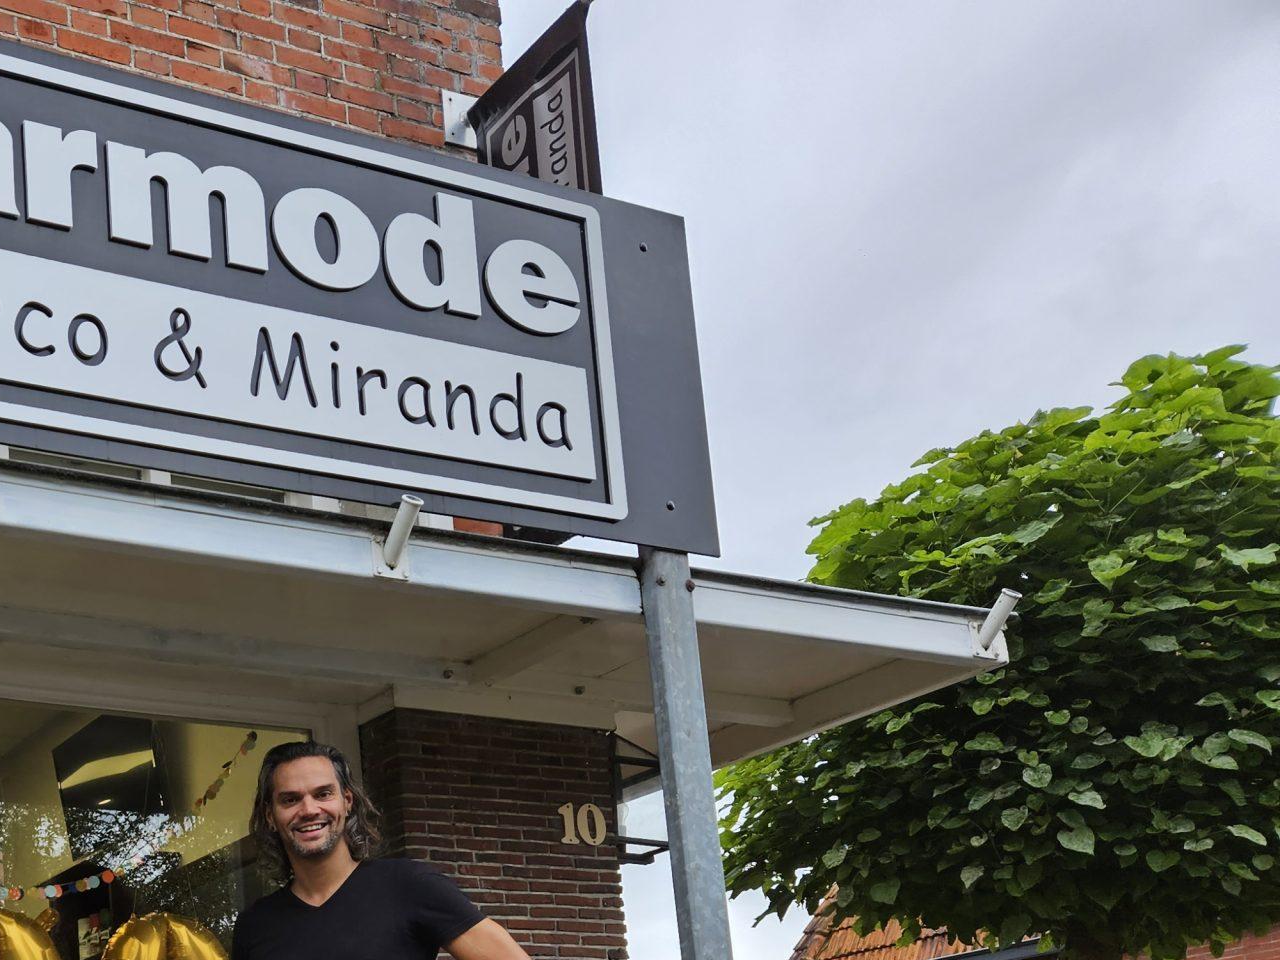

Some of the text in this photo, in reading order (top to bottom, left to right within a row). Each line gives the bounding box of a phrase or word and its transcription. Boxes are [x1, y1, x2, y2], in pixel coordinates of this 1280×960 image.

[540, 88, 570, 186] anda
[154, 307, 207, 388] &
[250, 326, 573, 451] Miranda
[558, 802, 607, 846] 10
